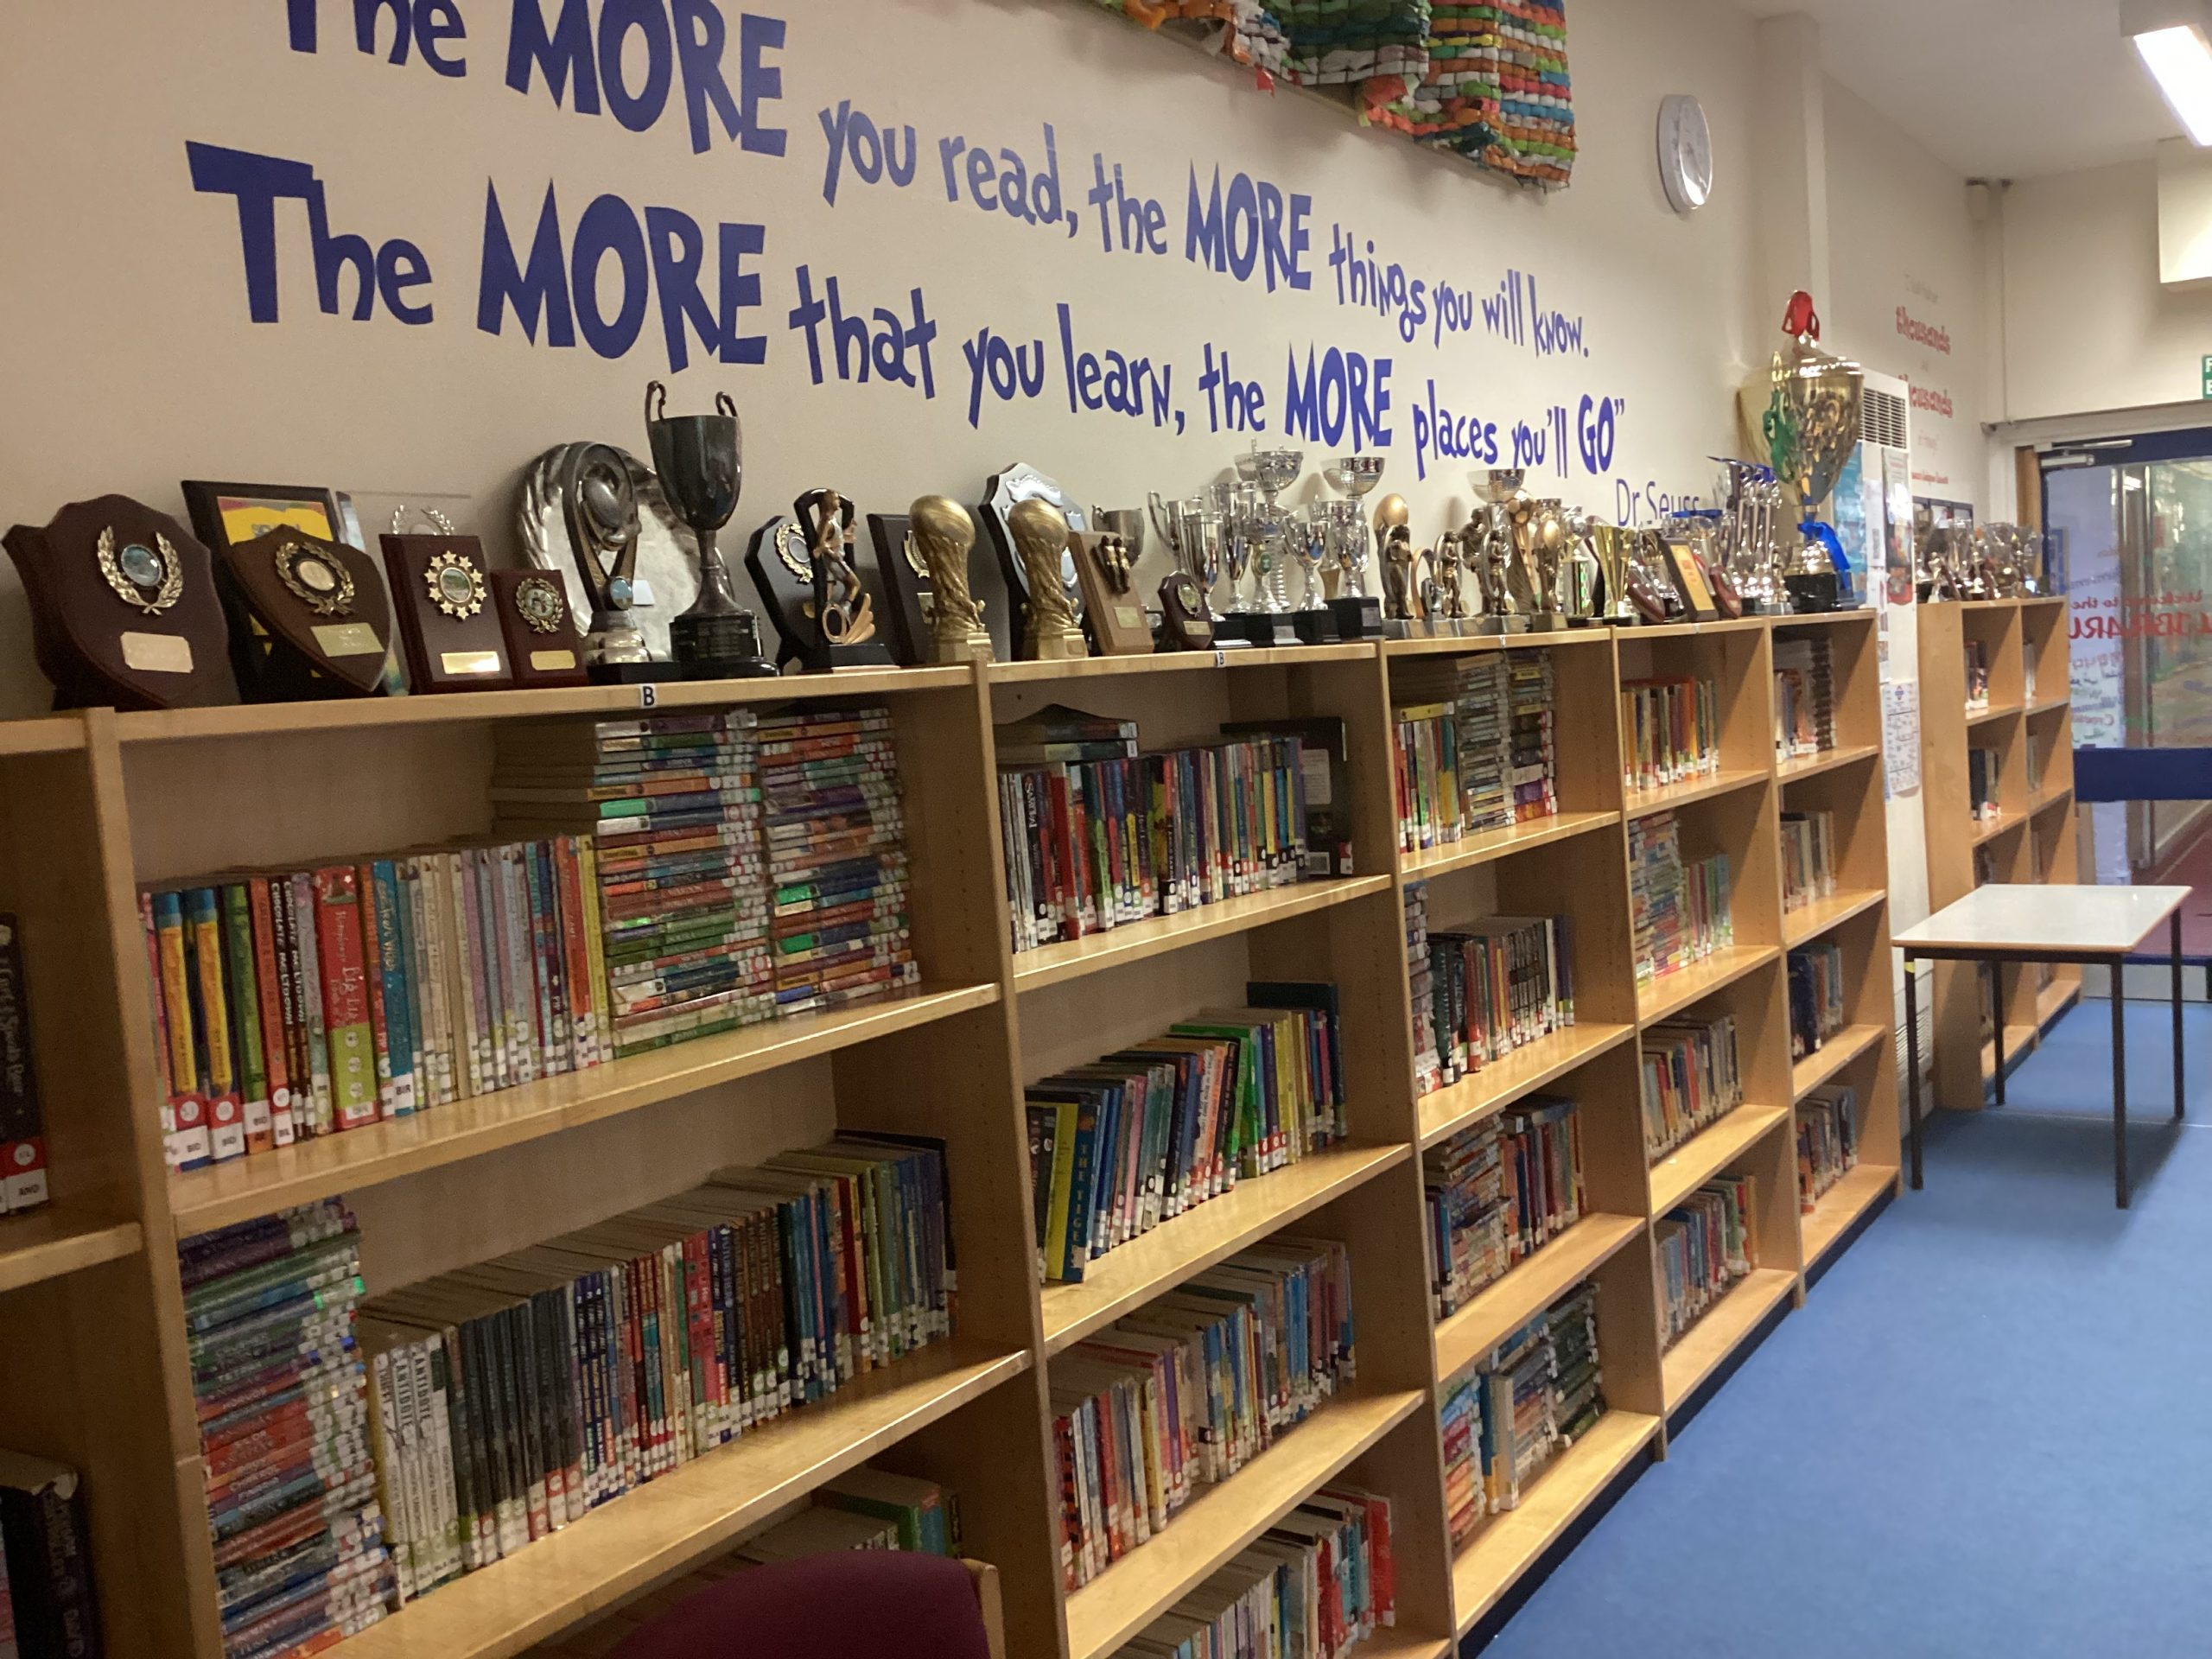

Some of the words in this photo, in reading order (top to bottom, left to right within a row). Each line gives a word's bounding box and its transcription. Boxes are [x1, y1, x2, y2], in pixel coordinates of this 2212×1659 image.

[505, 0, 787, 157] MORE
[817, 99, 917, 208] you
[938, 122, 1078, 238] read,
[1088, 152, 1167, 256] the
[1185, 158, 1312, 294] MORE
[1328, 223, 1427, 343] things
[1432, 280, 1474, 349] you
[1481, 269, 1524, 346] will
[1527, 273, 1589, 358] know.
[185, 141, 434, 325] The
[477, 175, 766, 374] MORE
[789, 264, 937, 399] that
[962, 326, 1045, 429] you
[1056, 302, 1185, 435] learn,
[1198, 341, 1265, 433] the
[1284, 340, 1393, 454] MORE
[1412, 379, 1498, 481] places
[1510, 407, 1568, 479] you'll
[1616, 479, 1640, 526] Dr
[1218, 652, 1224, 665] B
[642, 685, 655, 707] B
[271, 882, 286, 950] CHOCOLATE
[283, 880, 298, 945] CHOCOLATE
[291, 950, 306, 1023] MELTDOWN
[278, 951, 294, 1026] MELTDOWN
